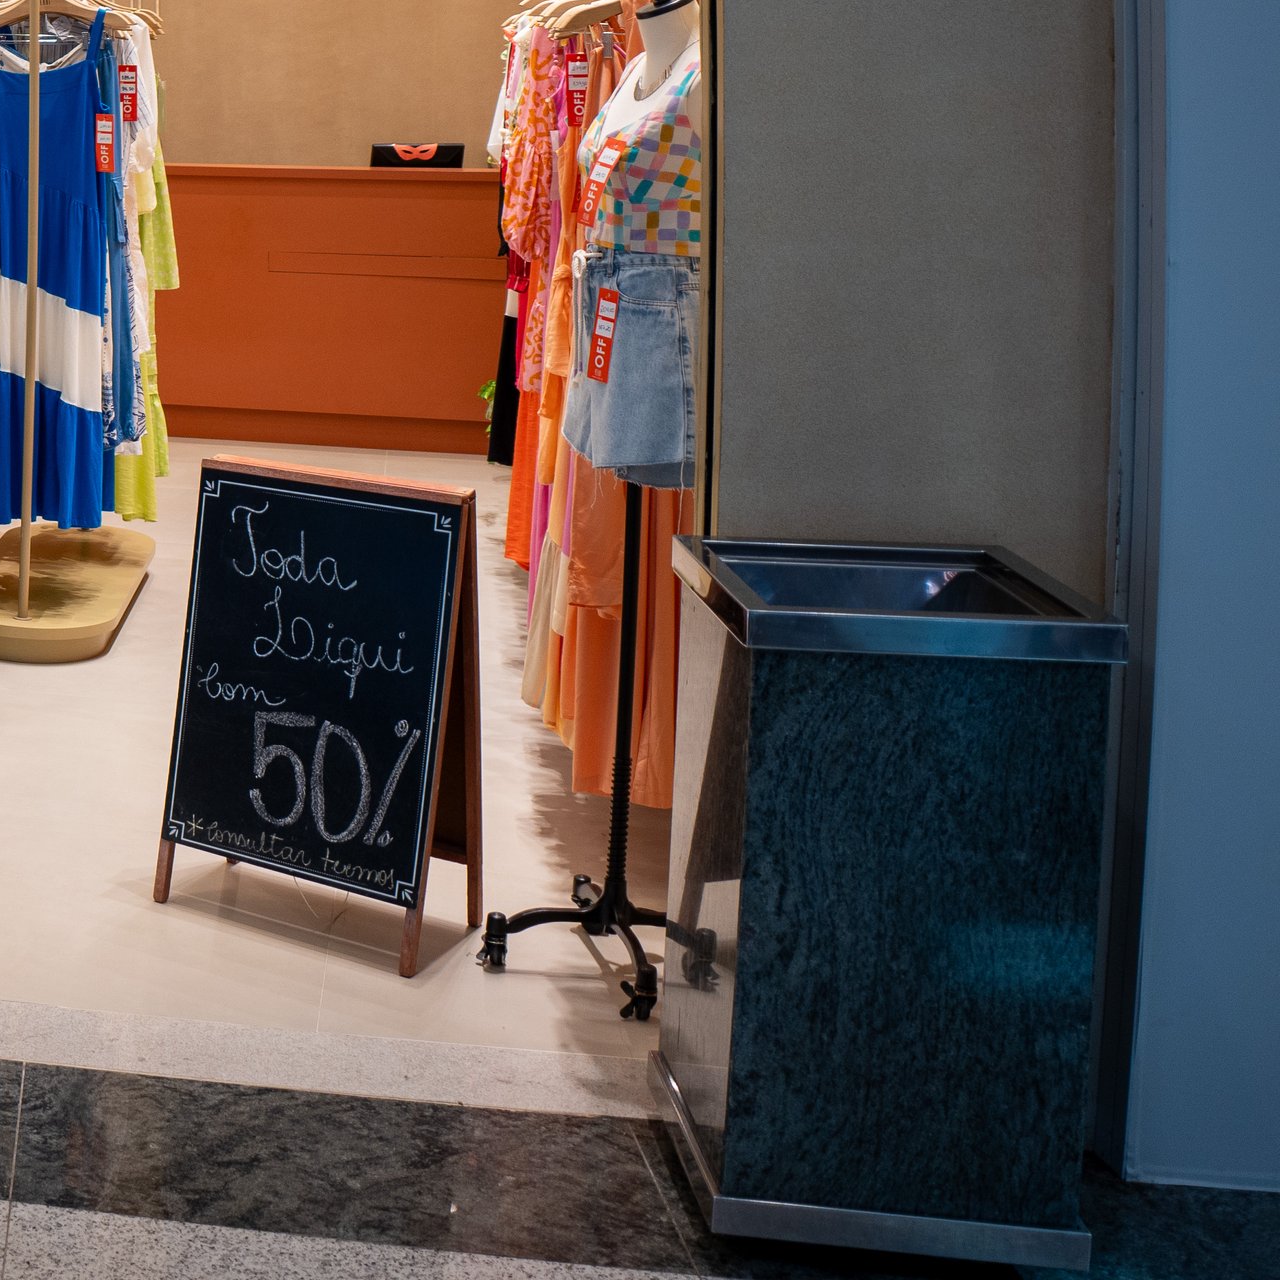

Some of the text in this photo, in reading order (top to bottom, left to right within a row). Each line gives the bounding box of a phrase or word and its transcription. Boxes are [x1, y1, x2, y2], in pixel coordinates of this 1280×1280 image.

[123, 94, 133, 114] OFF
[573, 92, 585, 116] OFF
[100, 144, 110, 164] OFF
[584, 182, 599, 212] OFF
[594, 338, 607, 369] OFF
[231, 500, 358, 592] Toda
[252, 585, 415, 699] Liqui
[249, 710, 422, 848] 50%
